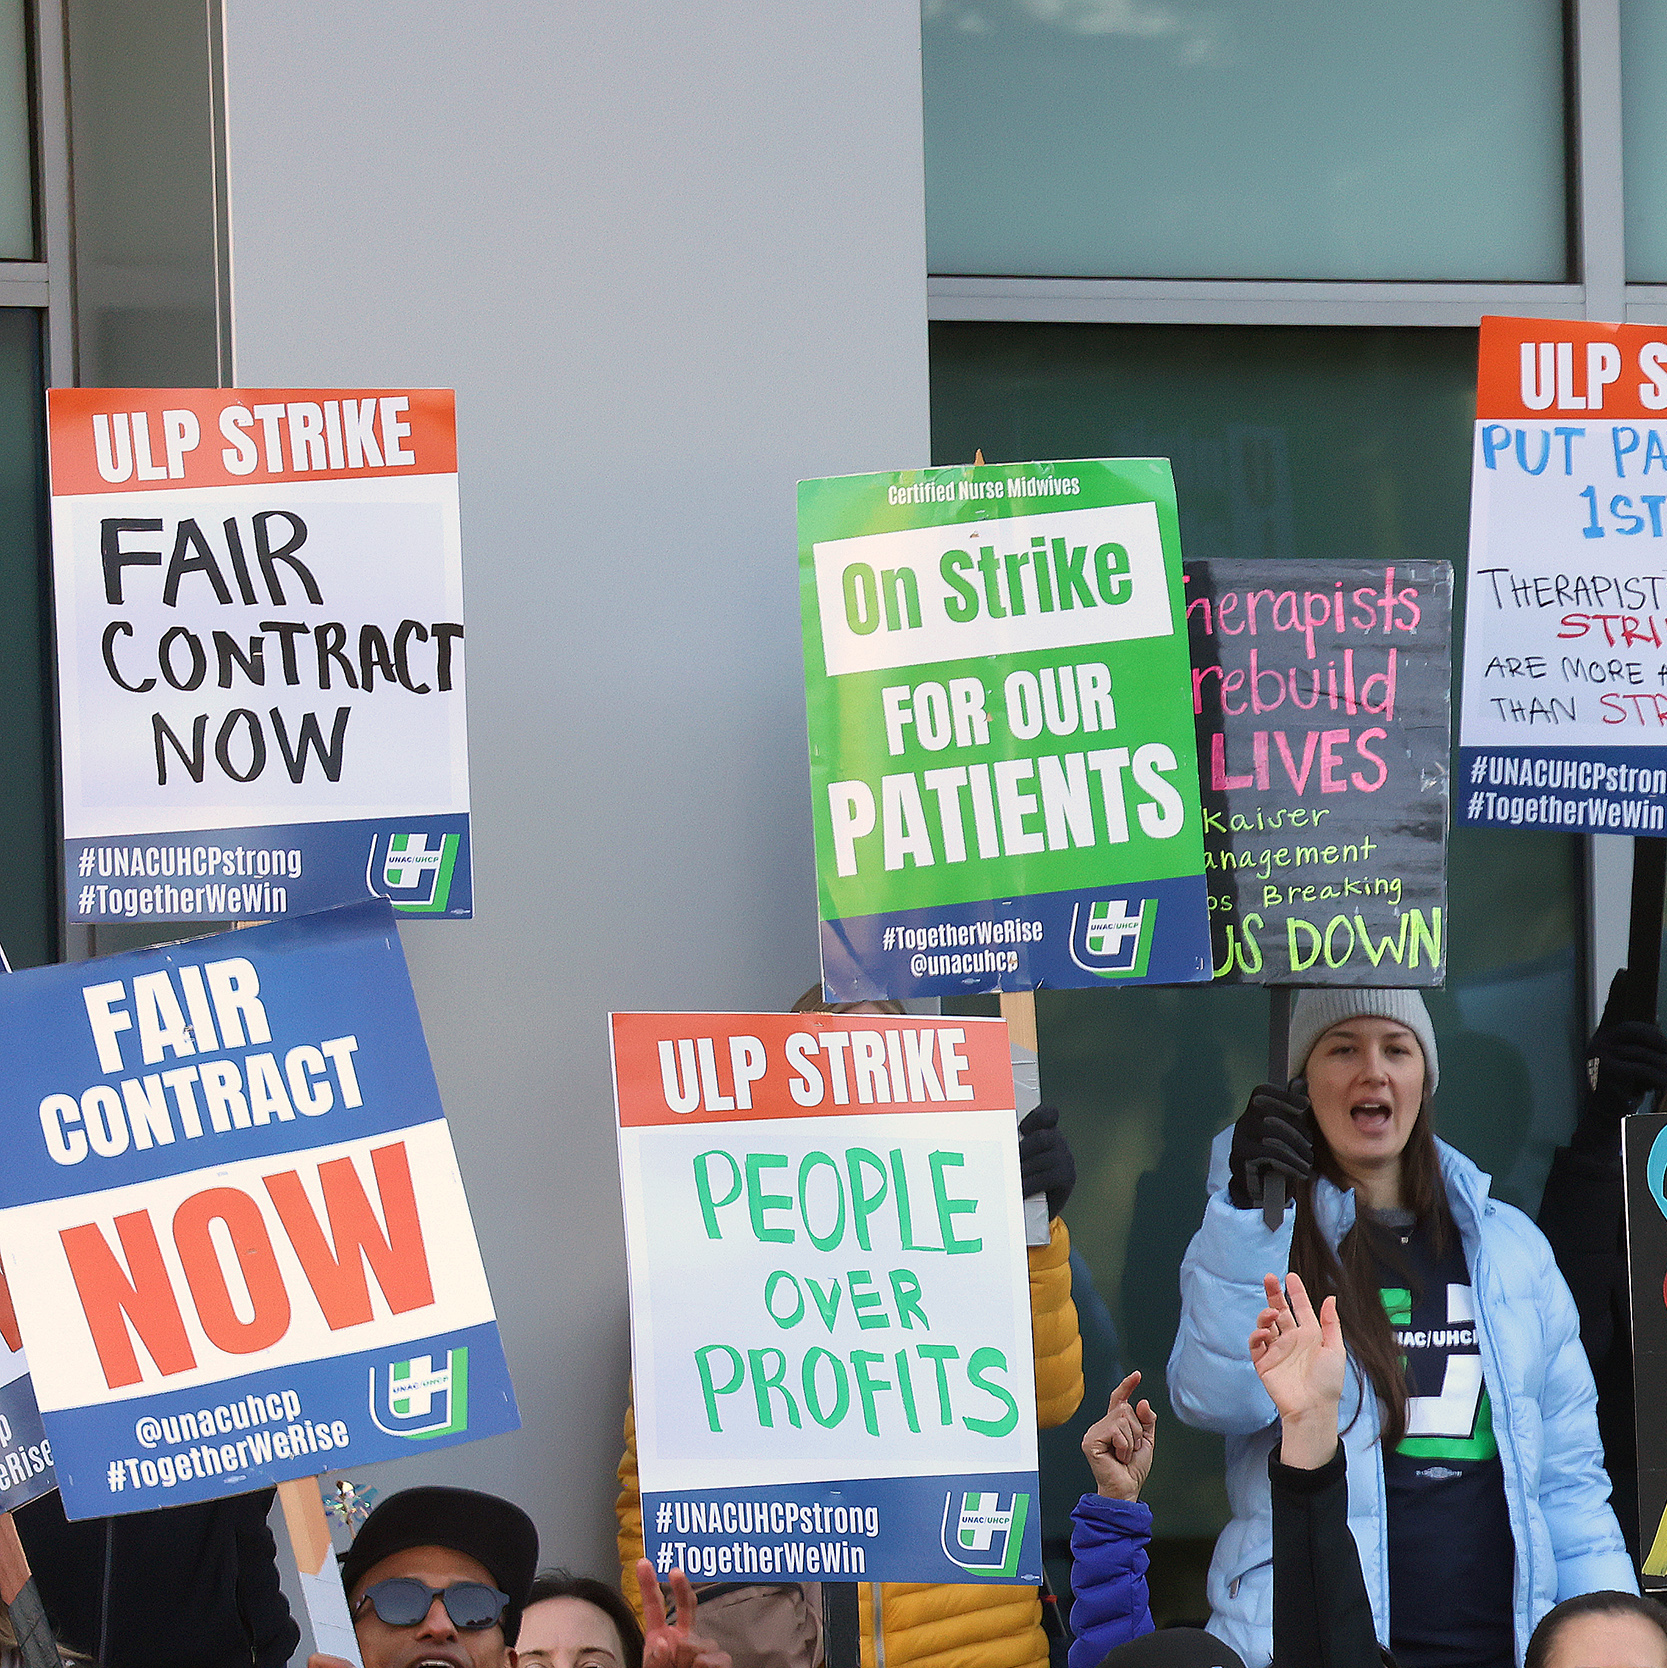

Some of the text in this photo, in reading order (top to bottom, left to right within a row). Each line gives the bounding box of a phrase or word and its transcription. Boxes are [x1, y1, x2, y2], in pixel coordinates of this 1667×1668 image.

[1520, 342, 1621, 410] ULP
[92, 396, 415, 483] ULP STRIKE
[1482, 425, 1585, 476] PUT
[888, 476, 1080, 505] Certified Nurse Midwives
[1579, 485, 1667, 538] 1ST
[100, 511, 323, 607] FAIR
[841, 536, 1133, 636] On Strike
[101, 619, 464, 694] CONTRACT
[1192, 648, 1397, 721] rebuild
[1484, 656, 1547, 679] ARE
[1562, 657, 1644, 685] MORE
[882, 662, 1116, 756] FOR OUR
[1491, 697, 1577, 724] THAN
[152, 707, 351, 785] NOW
[1211, 727, 1388, 796] LIVES
[828, 743, 1185, 877] PATIENTS
[1468, 791, 1665, 830] #TogetherWeWin
[78, 846, 302, 880] #UNACUHCPstrong
[388, 856, 439, 864] UNAC/UHCP
[1264, 875, 1402, 907] Breaking
[78, 881, 286, 918] #TogetherWeWin
[1090, 922, 1138, 931] UNAC/UHCP
[883, 919, 1043, 951] #TogetherWeRise
[910, 950, 1018, 977] @unacuhcp
[1287, 907, 1441, 973] DOWN
[83, 957, 272, 1074] FAIR
[39, 1036, 364, 1165] CONTRACT
[658, 1028, 975, 1114] ULP STRIKE
[694, 1148, 982, 1254] PEOPLE
[59, 1141, 435, 1390] NOW
[765, 1270, 928, 1333] OVER
[136, 1389, 301, 1450] @unacuhcp
[696, 1345, 1019, 1437] PROFITS
[107, 1419, 349, 1492] #TogetherWeRise
[656, 1501, 878, 1538] #UNACUHCPstrong
[962, 1516, 1010, 1524] UNAC/UHCP
[657, 1542, 865, 1578] #TogetherWeWin
